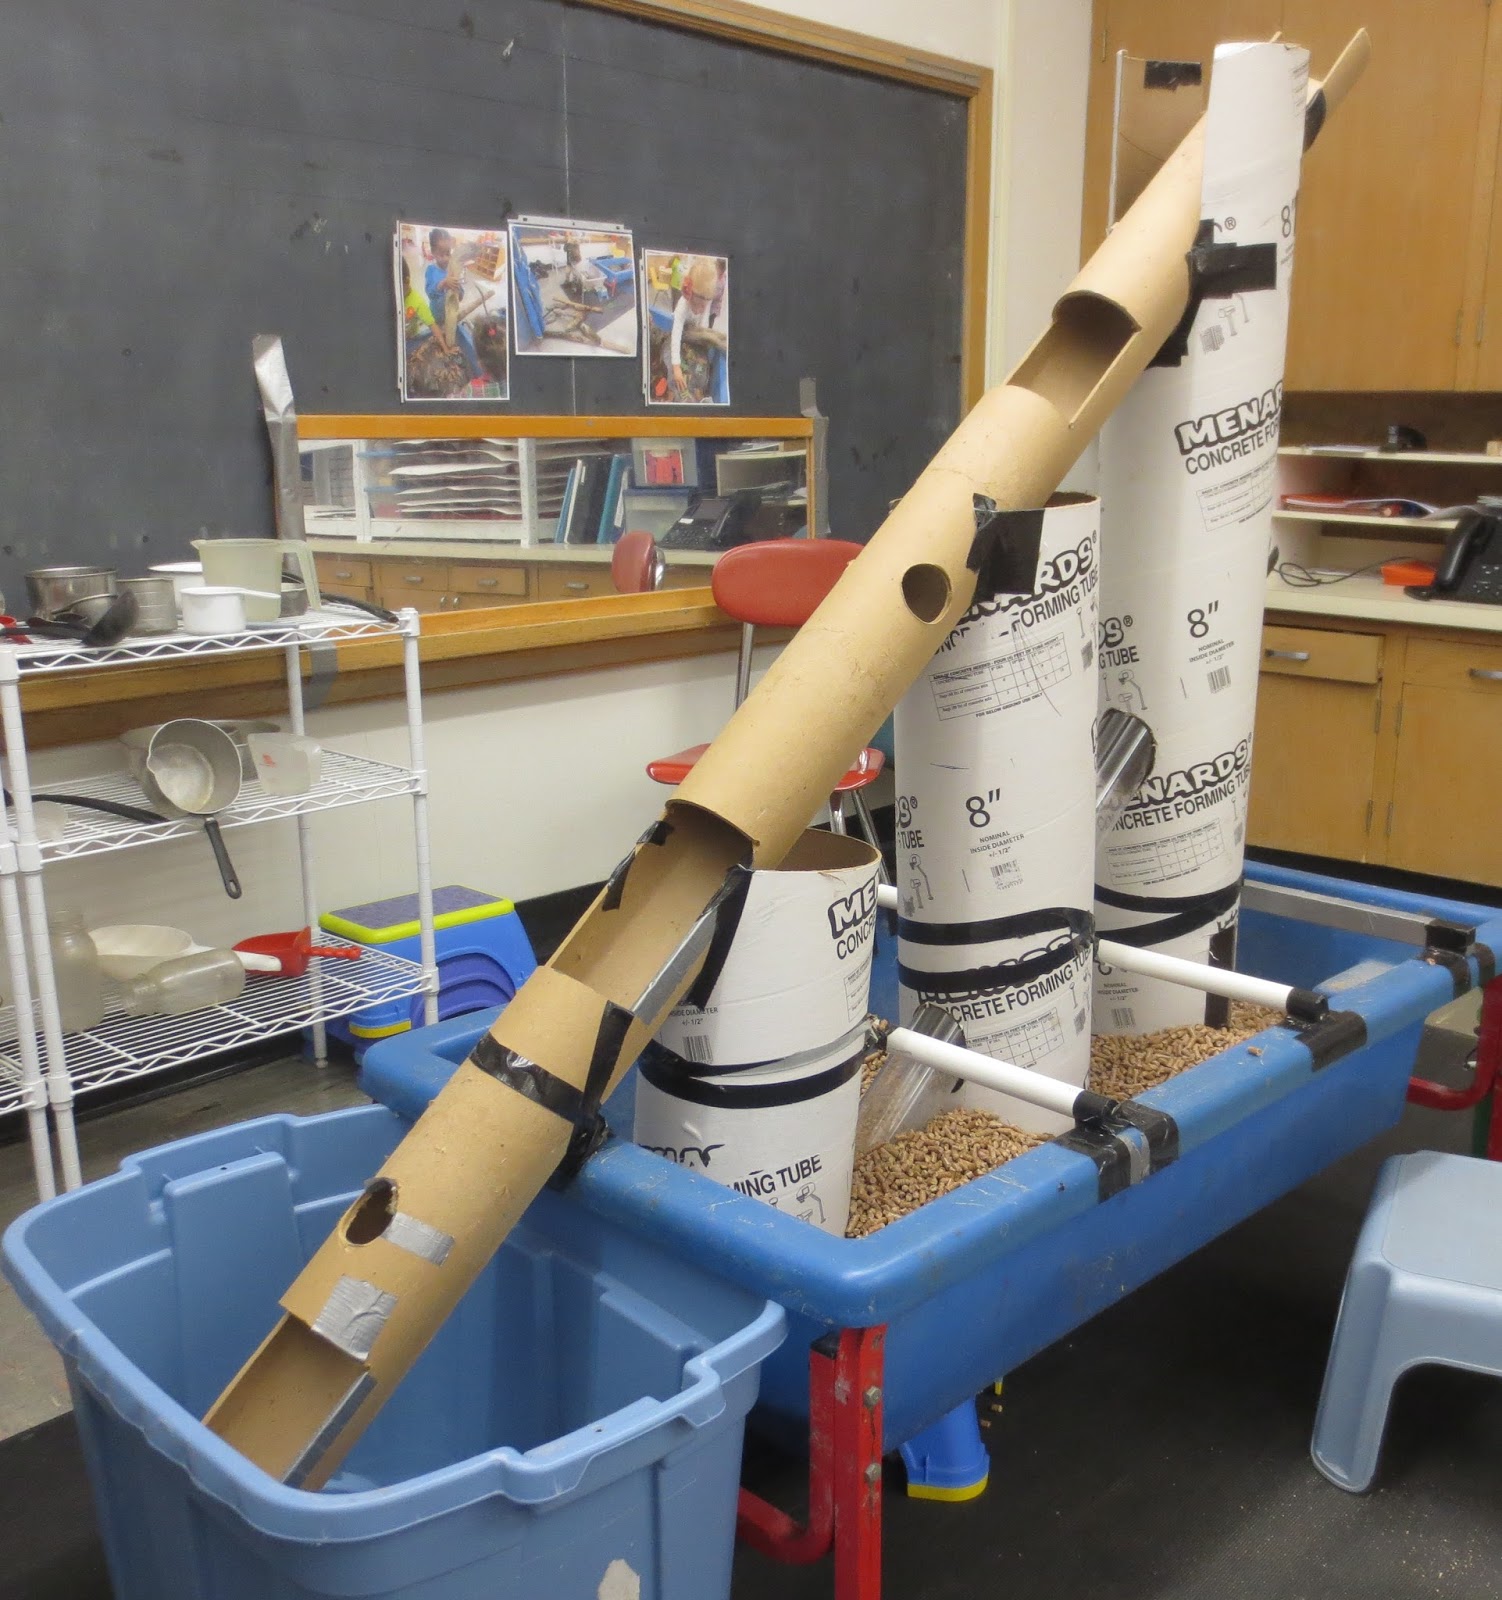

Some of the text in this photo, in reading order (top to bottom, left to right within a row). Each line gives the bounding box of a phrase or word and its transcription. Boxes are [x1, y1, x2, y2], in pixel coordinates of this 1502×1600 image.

[1185, 430, 1265, 475] CONCRETE
[1105, 645, 1140, 667] TUBE
[1174, 780, 1236, 819] FORMING
[900, 829, 925, 849] TUBE
[970, 833, 1025, 854] INSIDE DIAMETER
[979, 830, 1010, 843] NOMINAL
[946, 997, 1006, 1023] CRETE
[1006, 962, 1074, 1011] FORMING
[776, 1154, 823, 1188] TUBE
